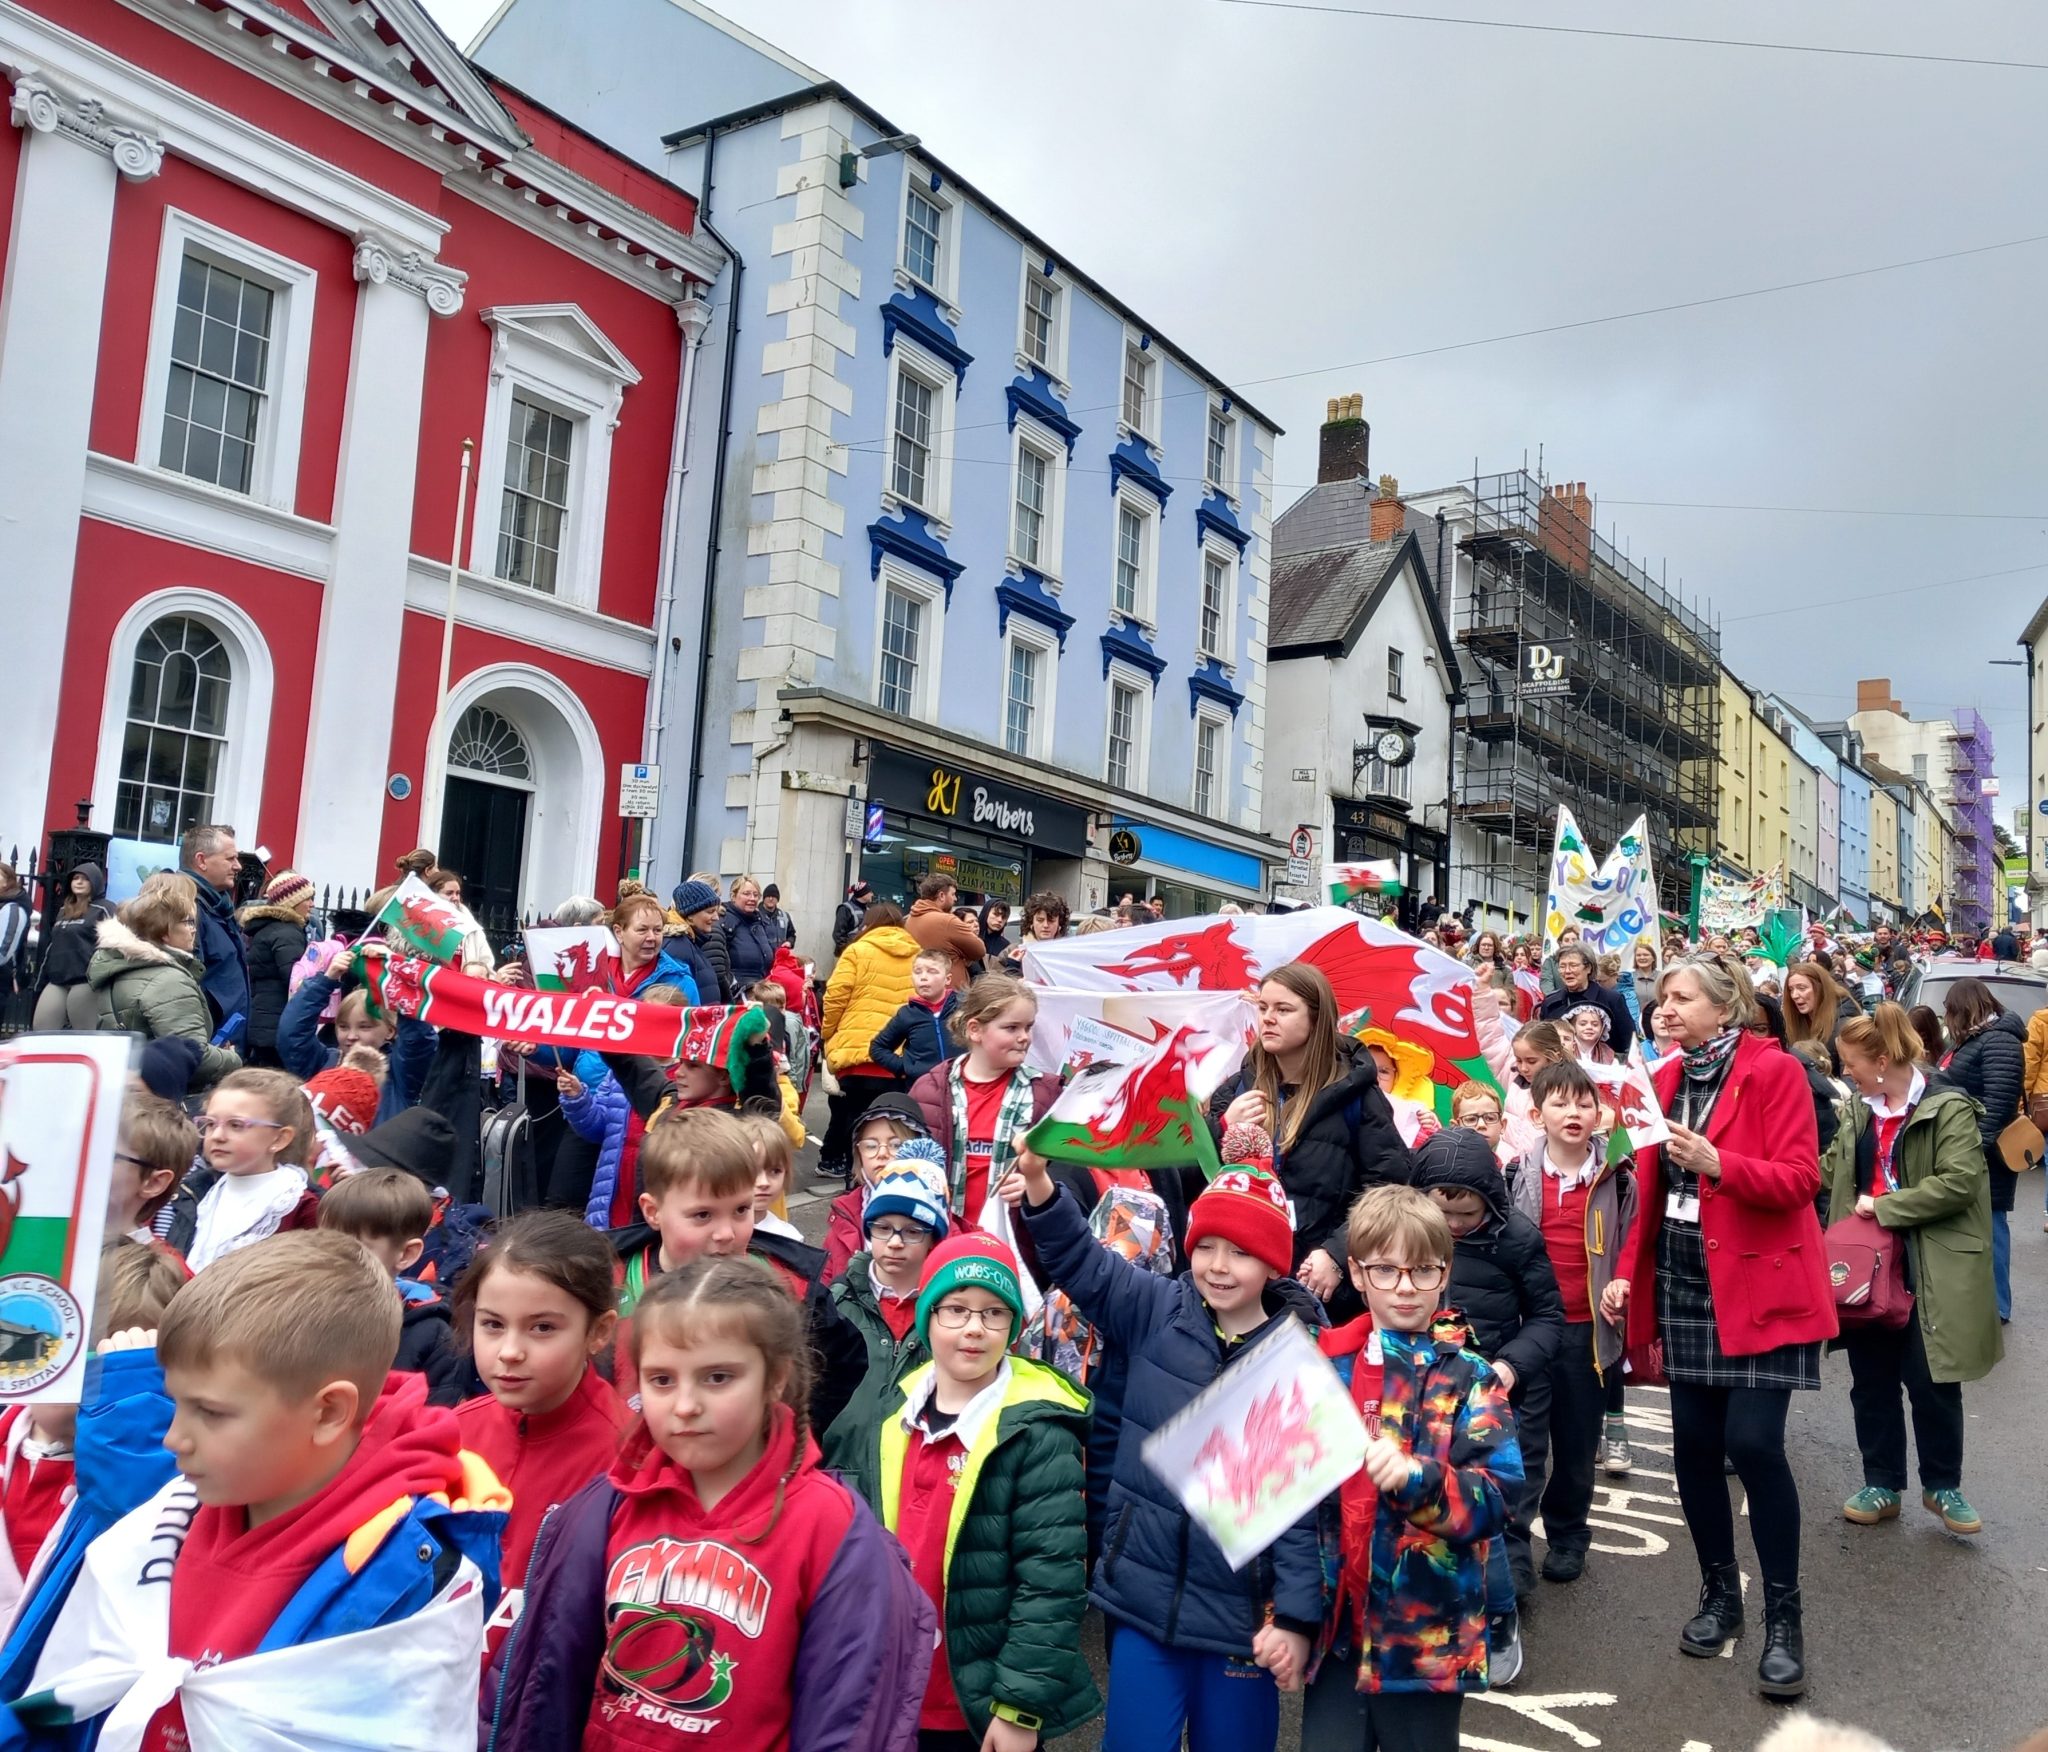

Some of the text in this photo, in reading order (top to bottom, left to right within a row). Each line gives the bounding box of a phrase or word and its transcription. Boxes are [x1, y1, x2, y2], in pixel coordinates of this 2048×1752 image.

[1528, 645, 1565, 680] D & J
[1522, 678, 1570, 688] SCAFFOLDING
[974, 786, 1035, 837] Barbers
[1350, 811, 1364, 824] 43
[939, 855, 955, 865] OPEN
[482, 989, 637, 1041] WALES
[39, 1283, 76, 1324] SCHOOL
[11, 1363, 61, 1391] SPITTAL
[605, 1537, 772, 1639] CYMRU
[635, 1703, 722, 1735] RUGBY
